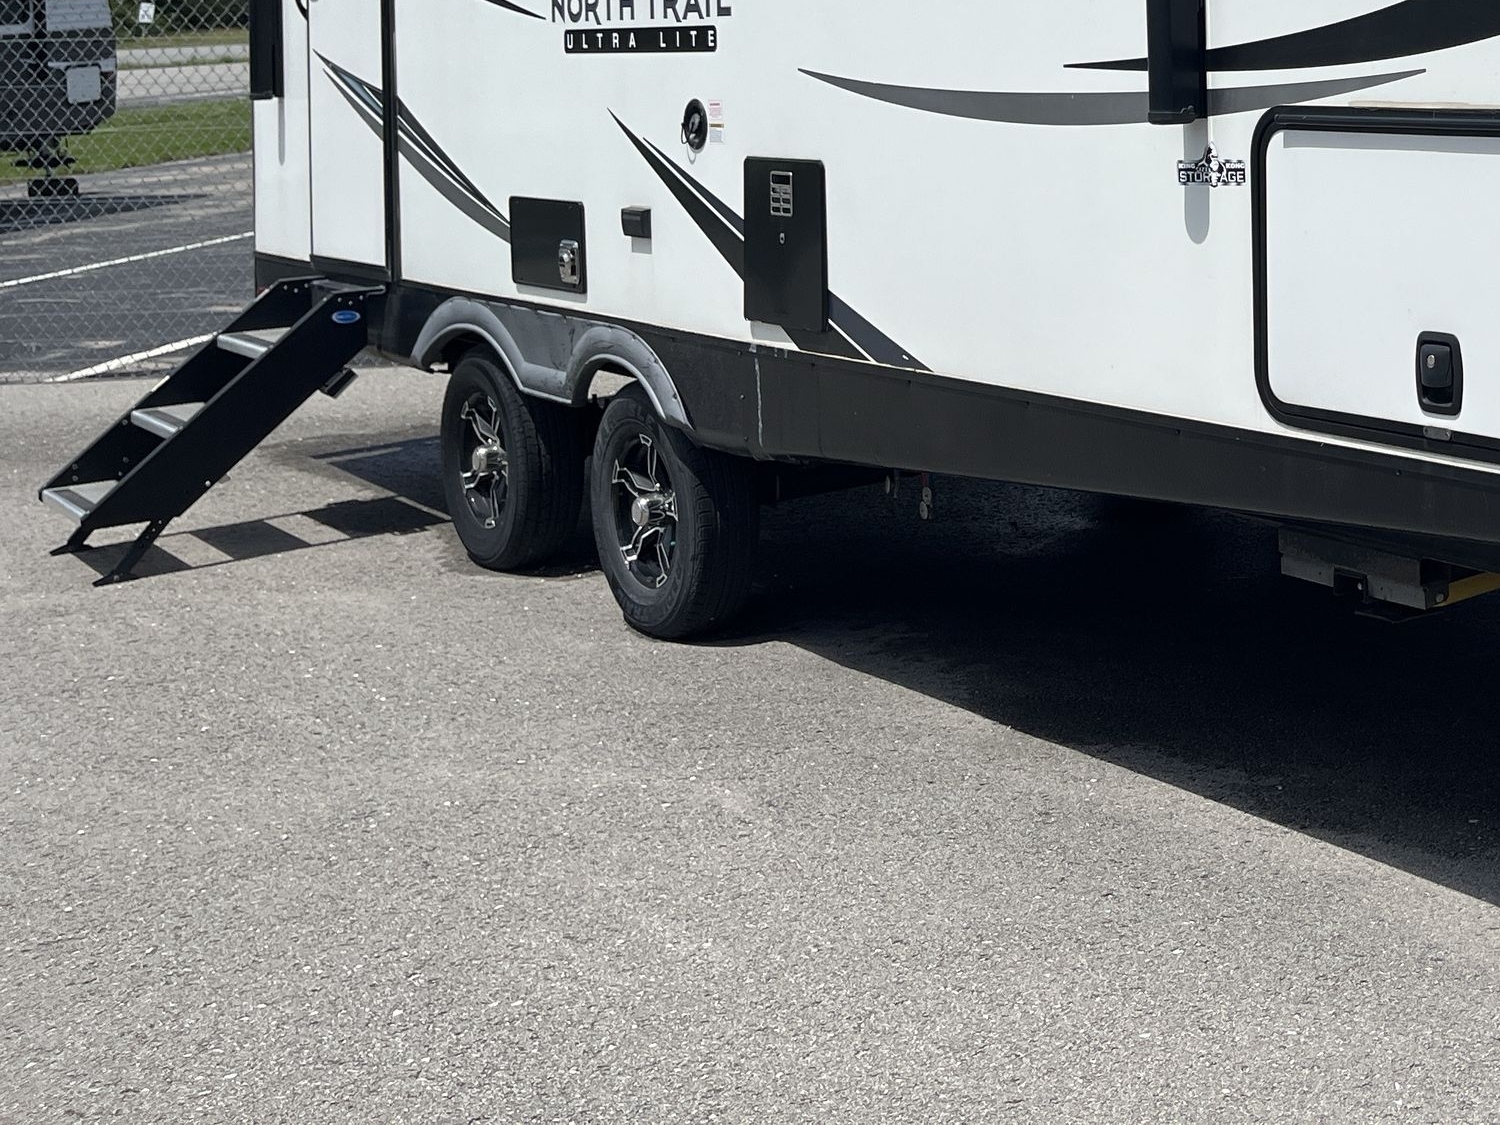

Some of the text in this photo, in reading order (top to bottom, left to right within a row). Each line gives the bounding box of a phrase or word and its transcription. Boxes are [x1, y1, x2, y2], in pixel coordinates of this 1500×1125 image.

[566, 30, 715, 49] ULTRA LITE
[1180, 171, 1244, 183] STORAGE
